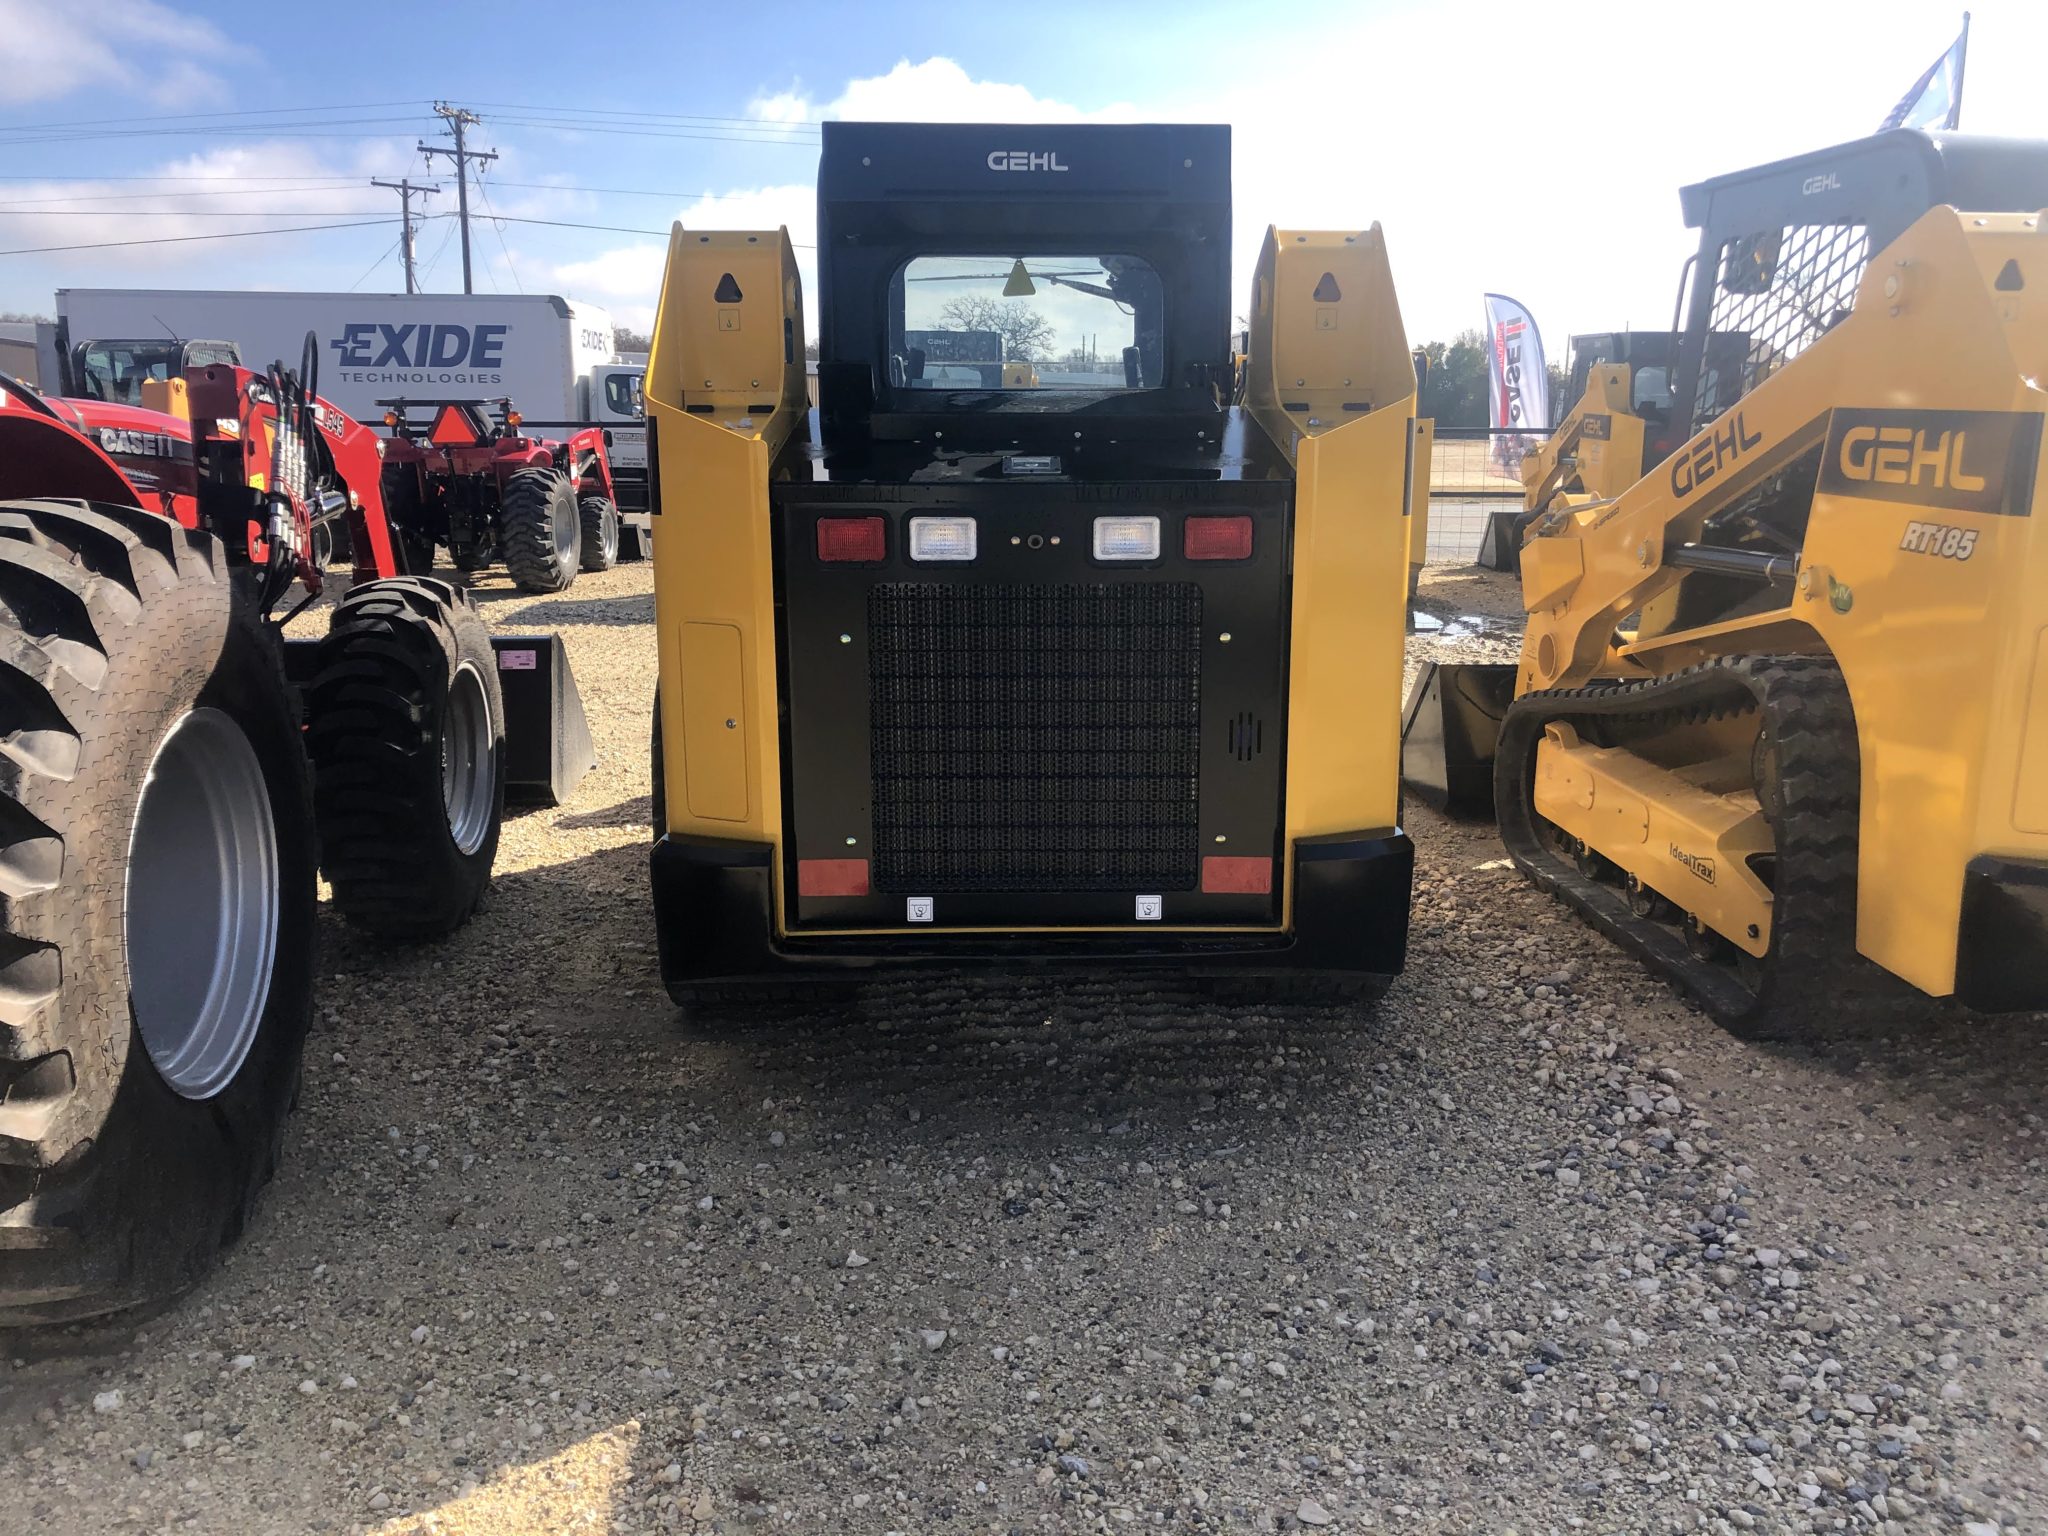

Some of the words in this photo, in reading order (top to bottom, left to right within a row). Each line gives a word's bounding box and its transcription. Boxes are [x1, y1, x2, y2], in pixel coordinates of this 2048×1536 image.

[987, 151, 1069, 171] GEHL
[1802, 172, 1841, 195] GEHL
[330, 323, 507, 368] EXIDE
[339, 372, 502, 384] TECHNOLOGIES
[1670, 410, 1762, 499] GEHL
[1840, 426, 1985, 492] GEHL
[1899, 520, 1980, 562] RT185
[1669, 841, 1715, 884] IdealTrax
